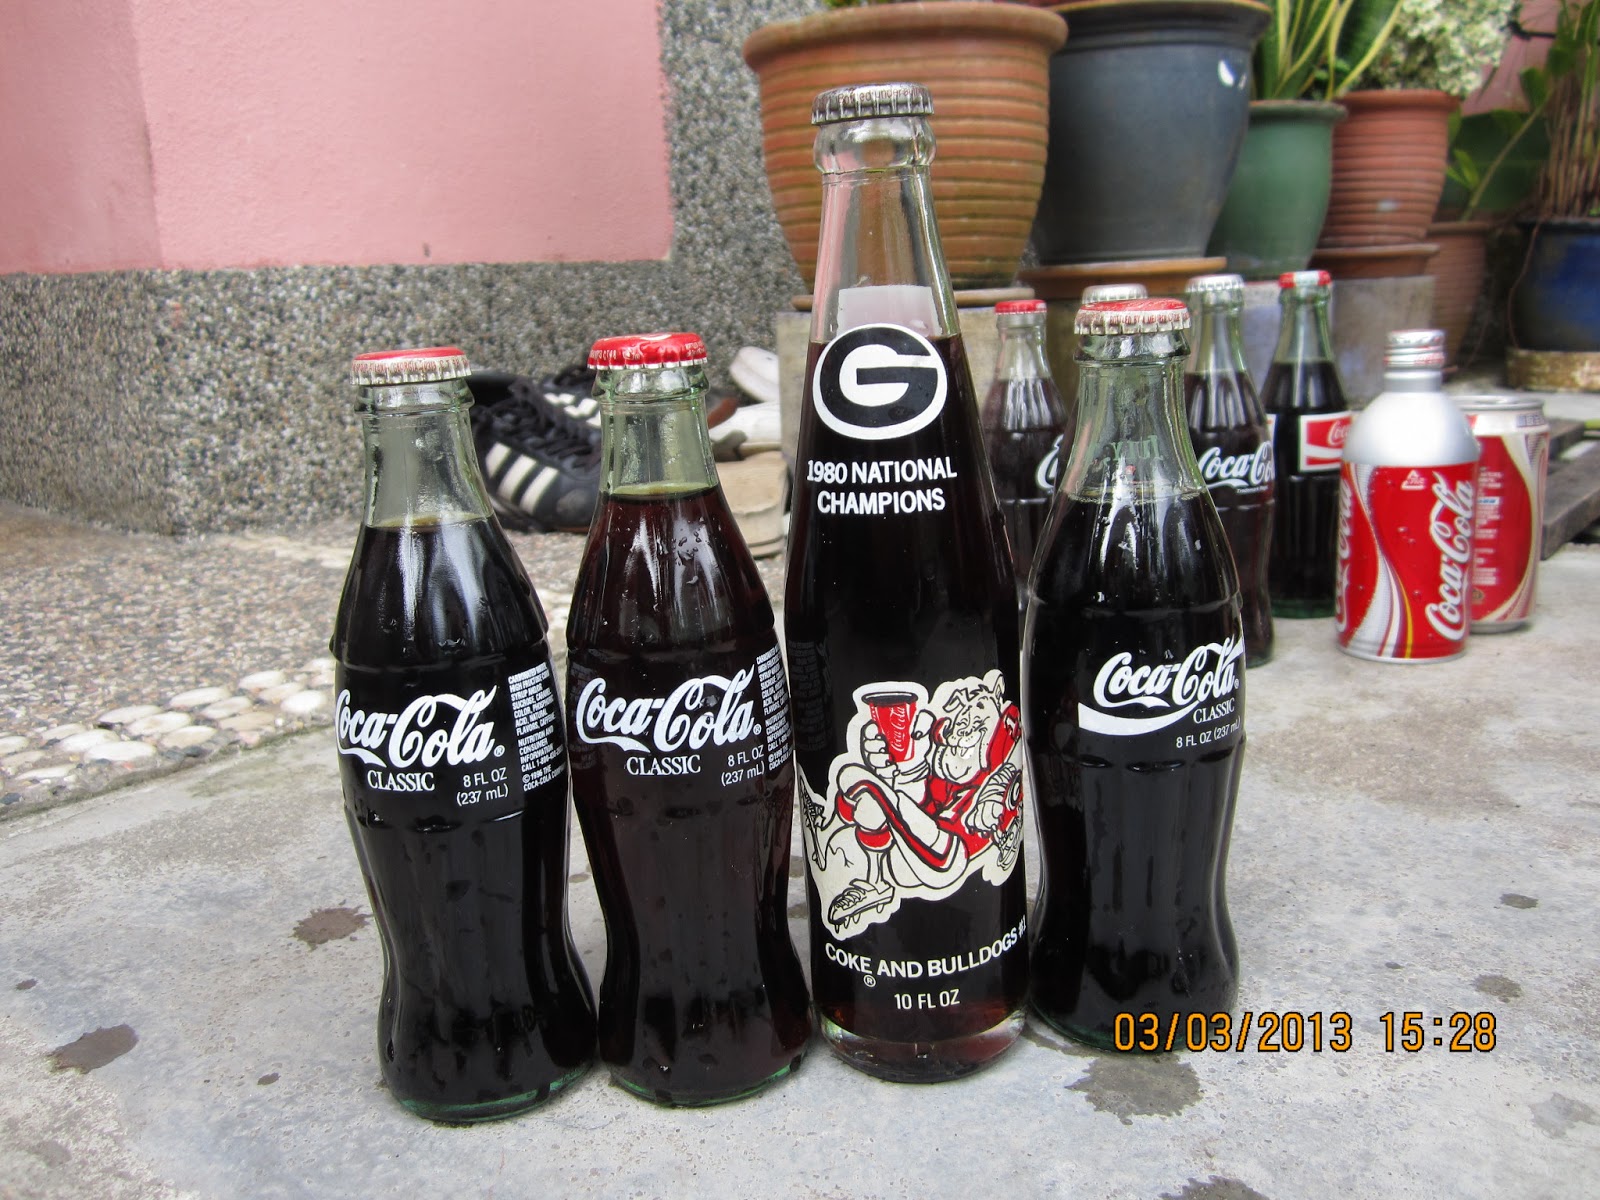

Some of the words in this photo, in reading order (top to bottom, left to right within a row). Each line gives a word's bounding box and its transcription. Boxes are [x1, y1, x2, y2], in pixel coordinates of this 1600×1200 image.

[806, 459, 848, 484] 1980
[851, 456, 958, 484] NATIONAL
[817, 487, 946, 515] CHAMPIONS
[1424, 470, 1475, 642] Coca-Cola
[1093, 634, 1238, 710] Coca-Cola
[511, 688, 528, 702] SYRUP
[576, 664, 755, 754] Coca-Cola
[1193, 697, 1236, 725] CLASSIC
[335, 684, 498, 769] Coca-Cola
[518, 729, 545, 748] NUTRITION
[889, 705, 906, 753] Coca-Cola
[1176, 736, 1184, 749] 8
[1185, 734, 1198, 748] FL
[1199, 731, 1212, 745] OZ
[1213, 723, 1231, 742] (237
[519, 738, 548, 756] CONSUMER
[520, 742, 554, 765] INFORMATION
[728, 754, 736, 768] 8
[737, 751, 751, 766] FL
[751, 744, 765, 760] OZ
[522, 760, 536, 773] CALL
[626, 754, 702, 776] CLASSIC
[720, 769, 743, 787] (237
[746, 761, 765, 780] mL)
[367, 769, 436, 793] CLASSIC
[463, 774, 471, 788] 8
[474, 771, 490, 787] FL
[491, 767, 508, 782] OZ
[524, 772, 552, 792] COCA-COLA
[456, 790, 482, 808] (237
[485, 785, 510, 803] mL)
[825, 942, 873, 974] COKE
[876, 959, 924, 979] AND
[927, 926, 1018, 978] BULLDOGS
[894, 993, 912, 1010] 10
[918, 993, 937, 1009] FL
[939, 988, 960, 1008] OZ
